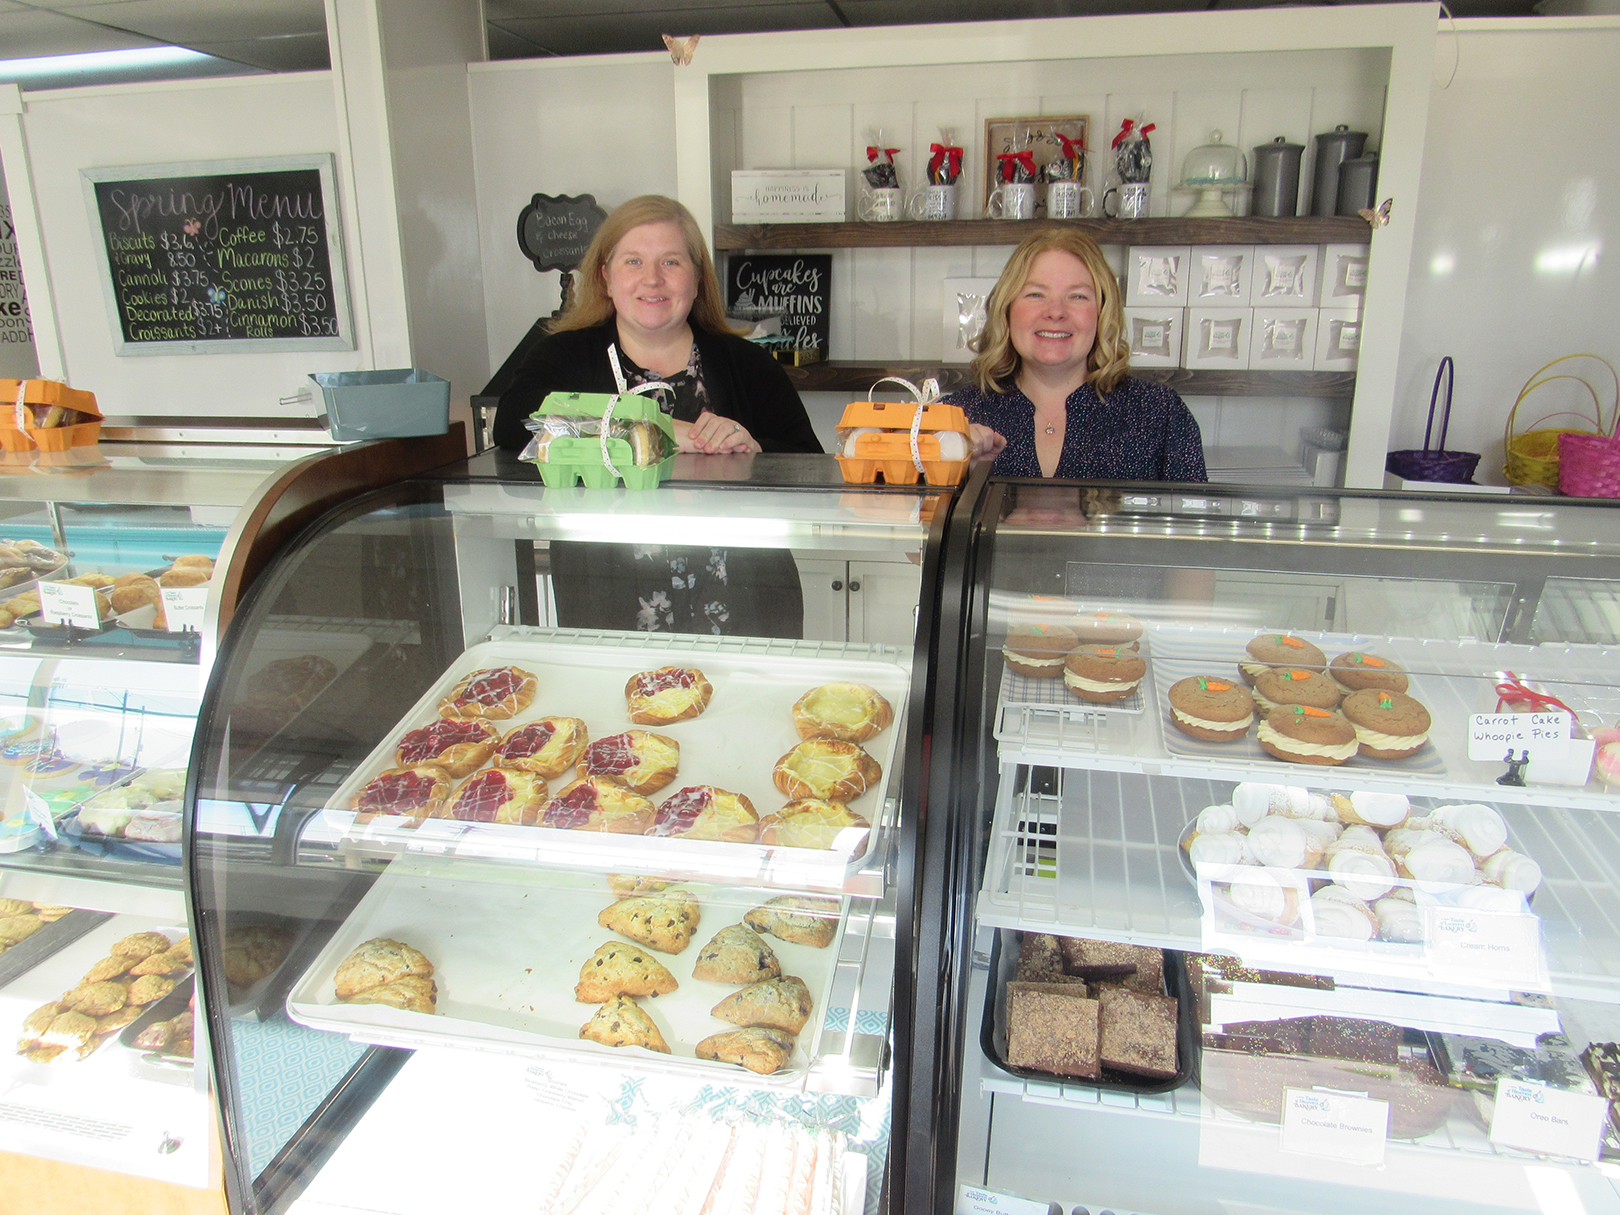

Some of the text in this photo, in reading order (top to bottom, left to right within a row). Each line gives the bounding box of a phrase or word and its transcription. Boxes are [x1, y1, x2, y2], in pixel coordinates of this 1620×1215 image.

[111, 183, 322, 240] Spring Menu
[535, 211, 589, 232] Bacon Egg
[219, 221, 319, 249] Coffee $2.75
[547, 229, 578, 241] cheese
[217, 246, 315, 269] Macarons $2
[119, 268, 209, 287] Cannoli $3.75
[218, 269, 326, 293] Scones $3.25
[736, 259, 823, 296] Cupcakes
[121, 286, 190, 305] Cookies $2
[771, 281, 797, 296] are
[126, 298, 223, 322] Decorated $3.75
[227, 290, 327, 314] Danish $3.50
[758, 294, 823, 314] MUFFINS
[129, 322, 197, 340] Croissants
[229, 311, 338, 336] Cinnamon $3.50
[246, 326, 274, 338] Rolls
[1475, 714, 1561, 725] Carrot Cake
[1473, 728, 1559, 742] Whoopie Pies
[1460, 941, 1511, 952] Cream Horns
[1300, 1117, 1373, 1134] Chocolate Brownies
[1530, 1111, 1569, 1126] Oreo Bars
